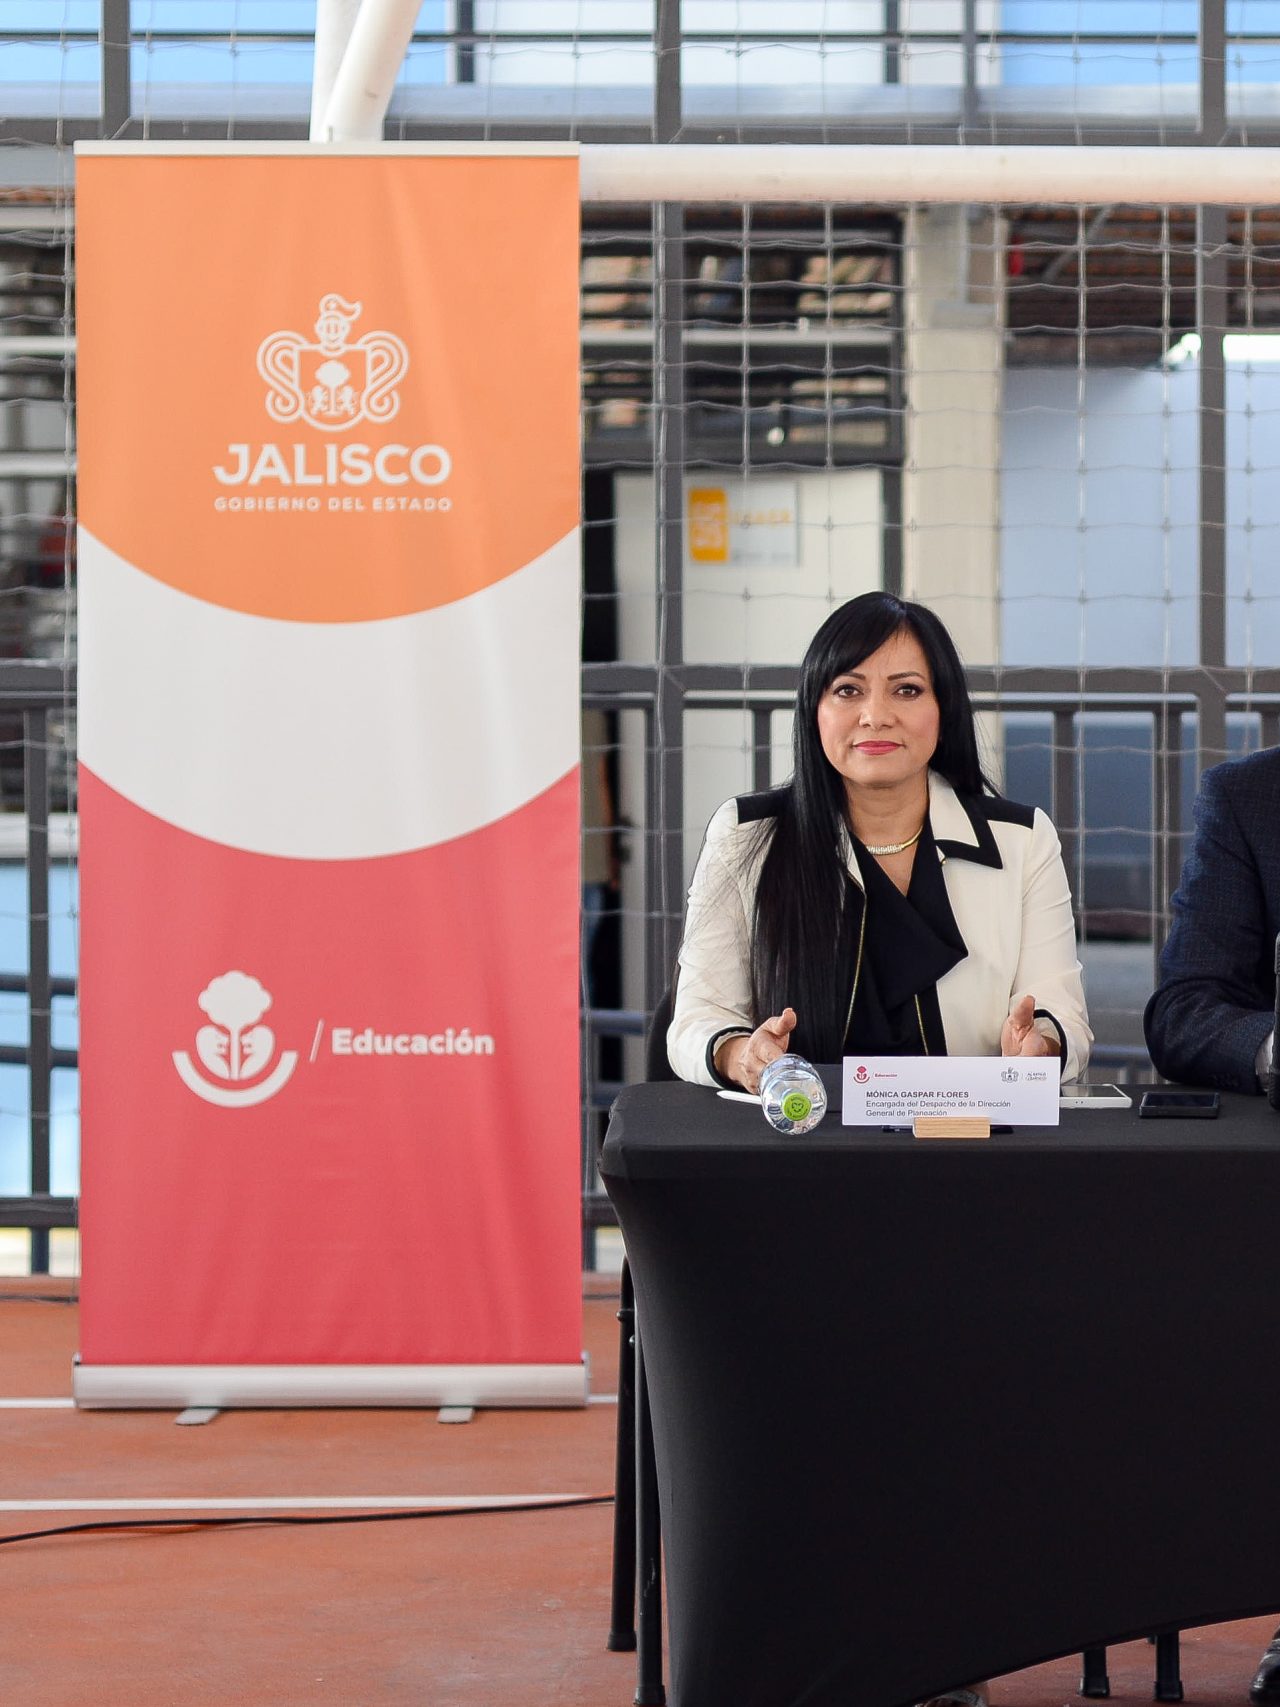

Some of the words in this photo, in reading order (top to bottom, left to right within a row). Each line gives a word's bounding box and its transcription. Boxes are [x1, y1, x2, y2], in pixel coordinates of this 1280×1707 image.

[212, 443, 452, 485] JALISCO
[214, 497, 321, 512] GOBIERNO
[328, 497, 365, 512] DEL
[372, 497, 452, 512] ESTADO
[331, 1026, 495, 1055] Educación
[866, 1090, 899, 1098] MÓNICA
[866, 1100, 905, 1109] Encargada
[919, 1100, 956, 1109] Despacho
[977, 1100, 1011, 1108] Dirección
[866, 1109, 895, 1117] General
[896, 1109, 906, 1117] de
[907, 1109, 948, 1117] Planeación
